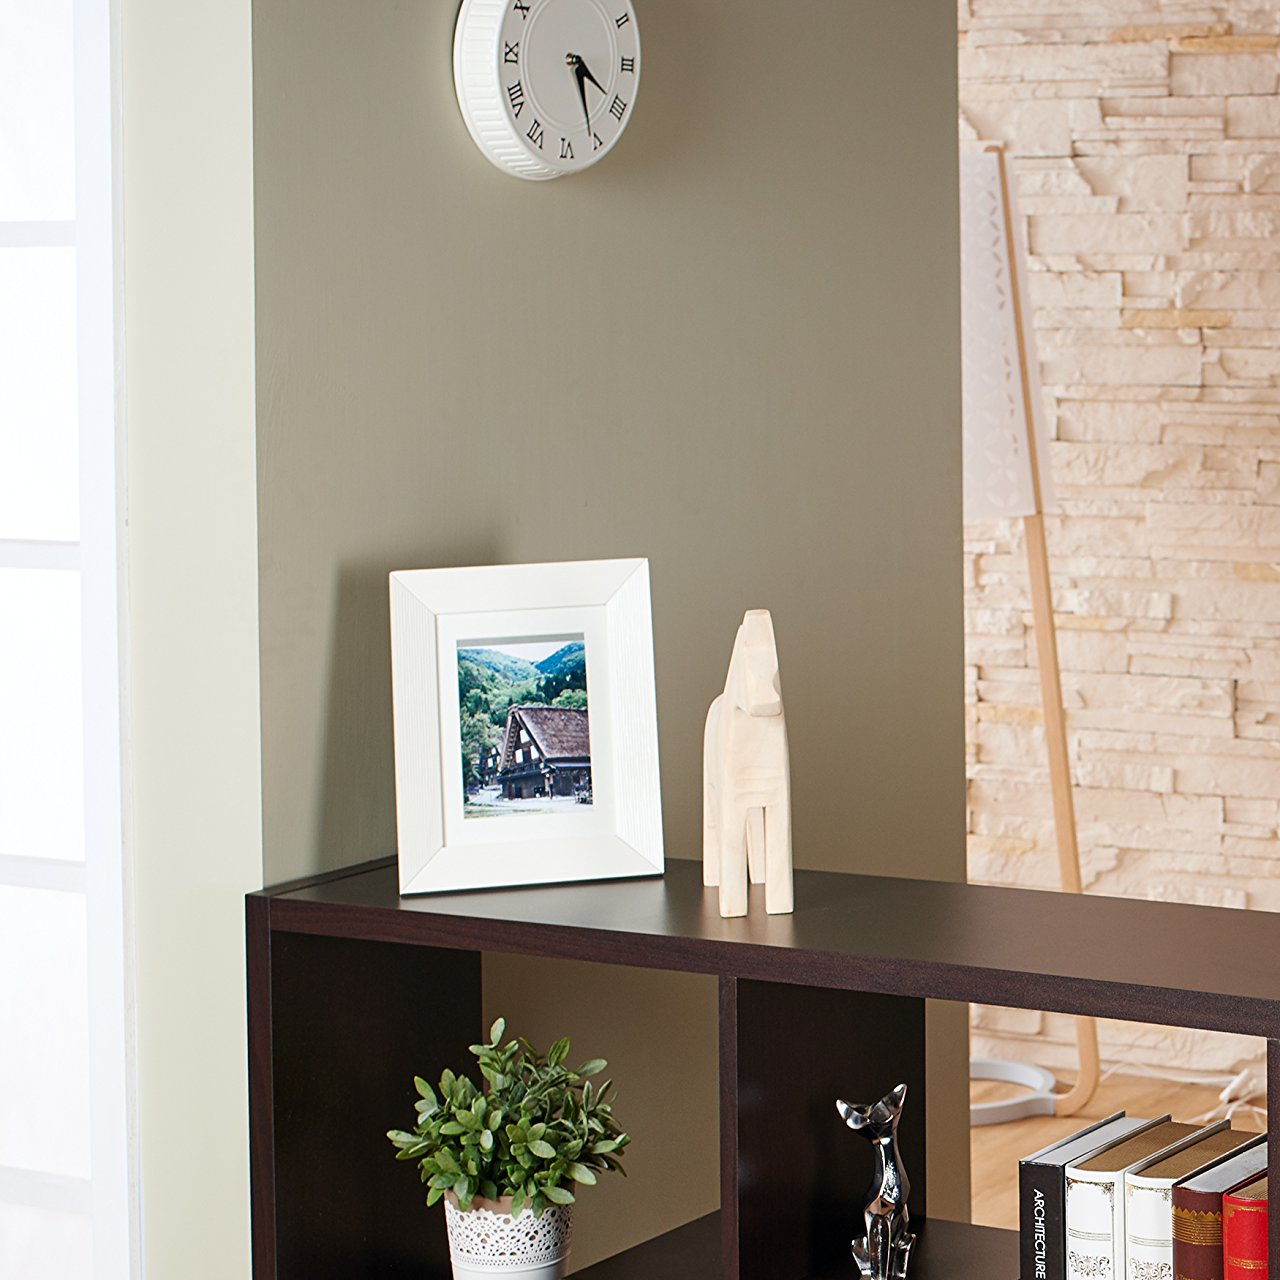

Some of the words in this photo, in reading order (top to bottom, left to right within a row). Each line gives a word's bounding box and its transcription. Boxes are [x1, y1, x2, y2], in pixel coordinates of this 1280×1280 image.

[615, 13, 629, 29] II
[503, 41, 519, 64] IX
[621, 56, 634, 73] III
[507, 80, 525, 119] VIII
[609, 94, 627, 121] IIII
[526, 119, 544, 149] VII
[592, 132, 603, 150] V
[560, 138, 574, 159] VI
[1033, 1188, 1047, 1280] ARCHITECTURE
